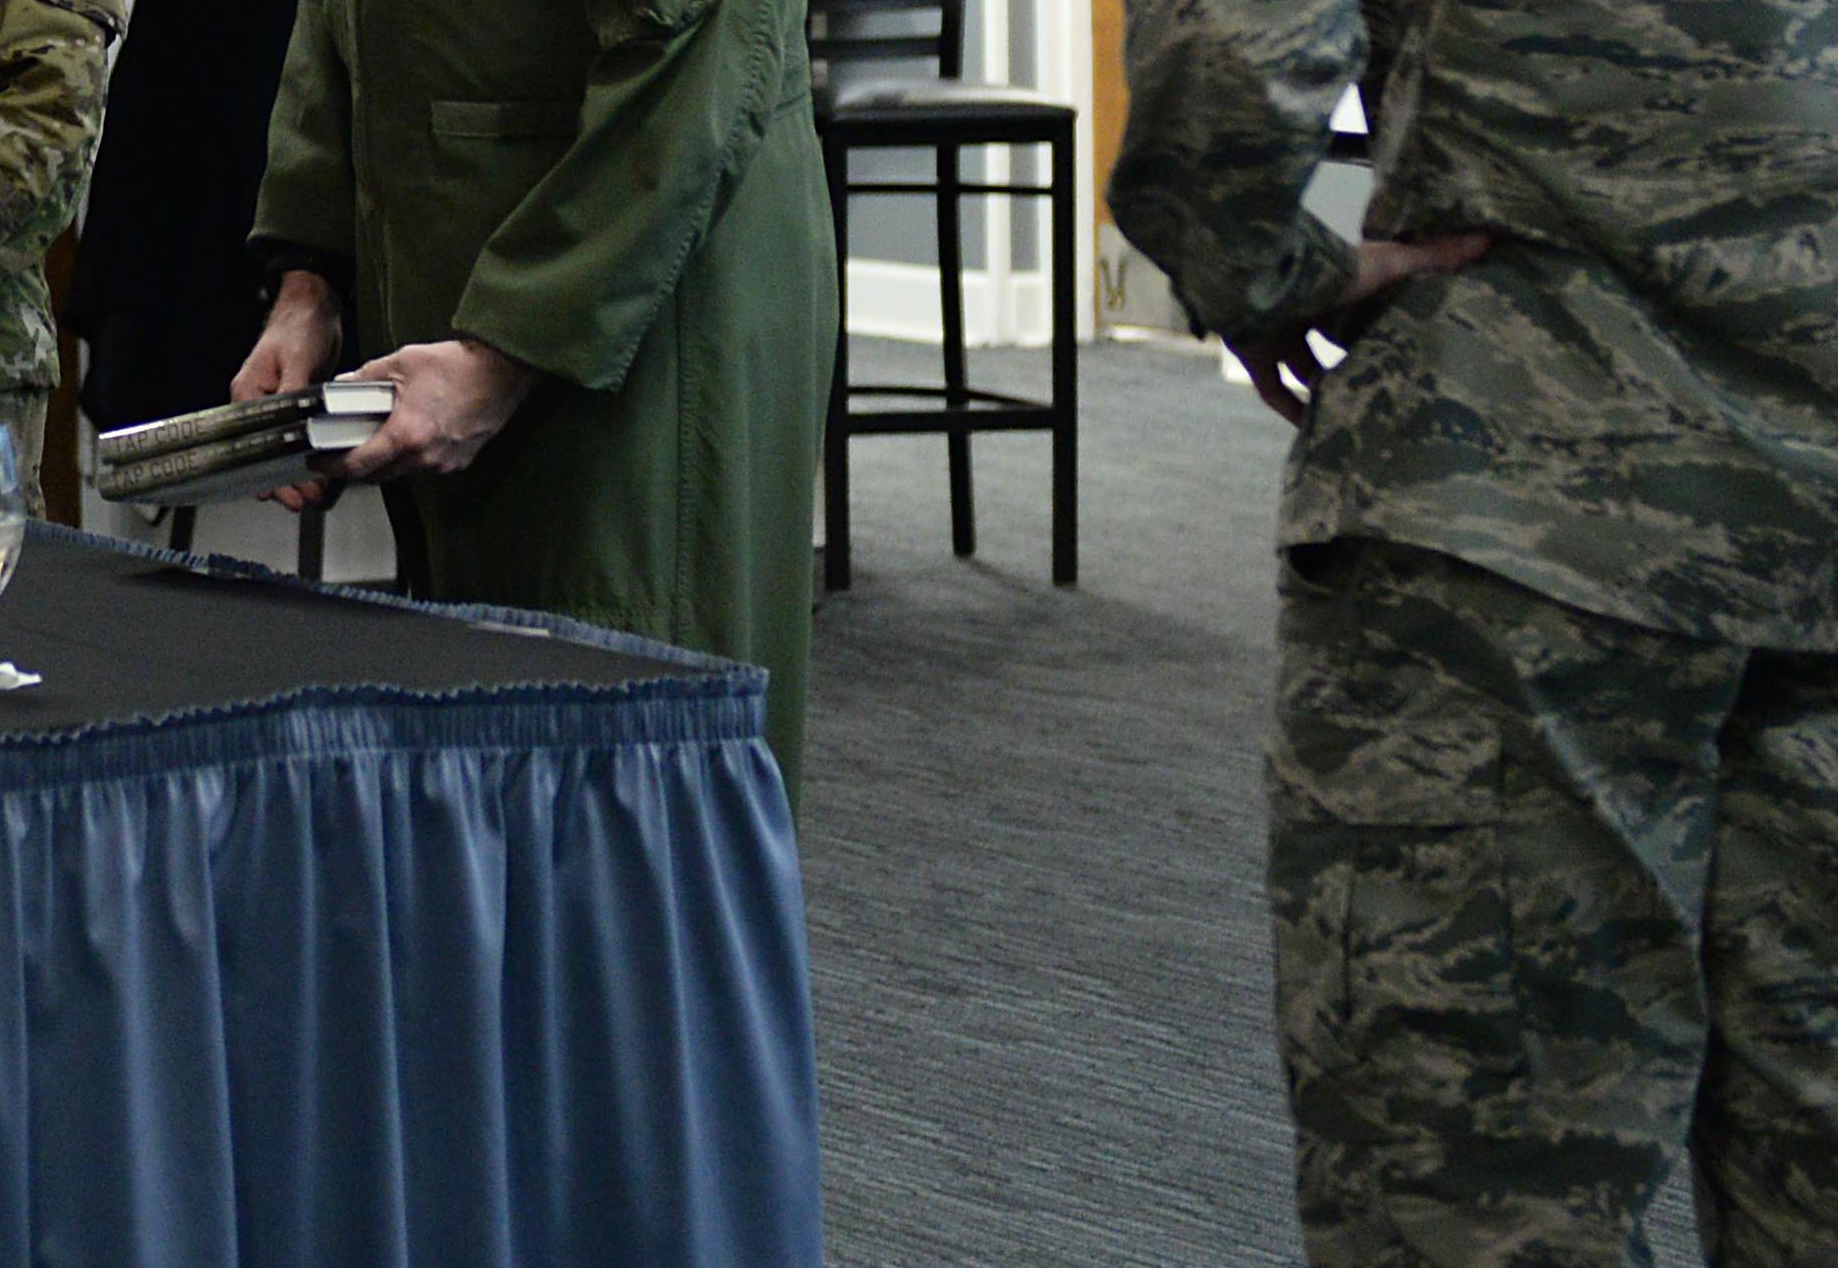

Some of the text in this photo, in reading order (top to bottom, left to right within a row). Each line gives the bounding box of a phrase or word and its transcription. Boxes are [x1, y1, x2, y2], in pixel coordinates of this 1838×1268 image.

[112, 432, 149, 454] TAP
[154, 417, 208, 444] CODE
[110, 451, 200, 490] TAP CODE
